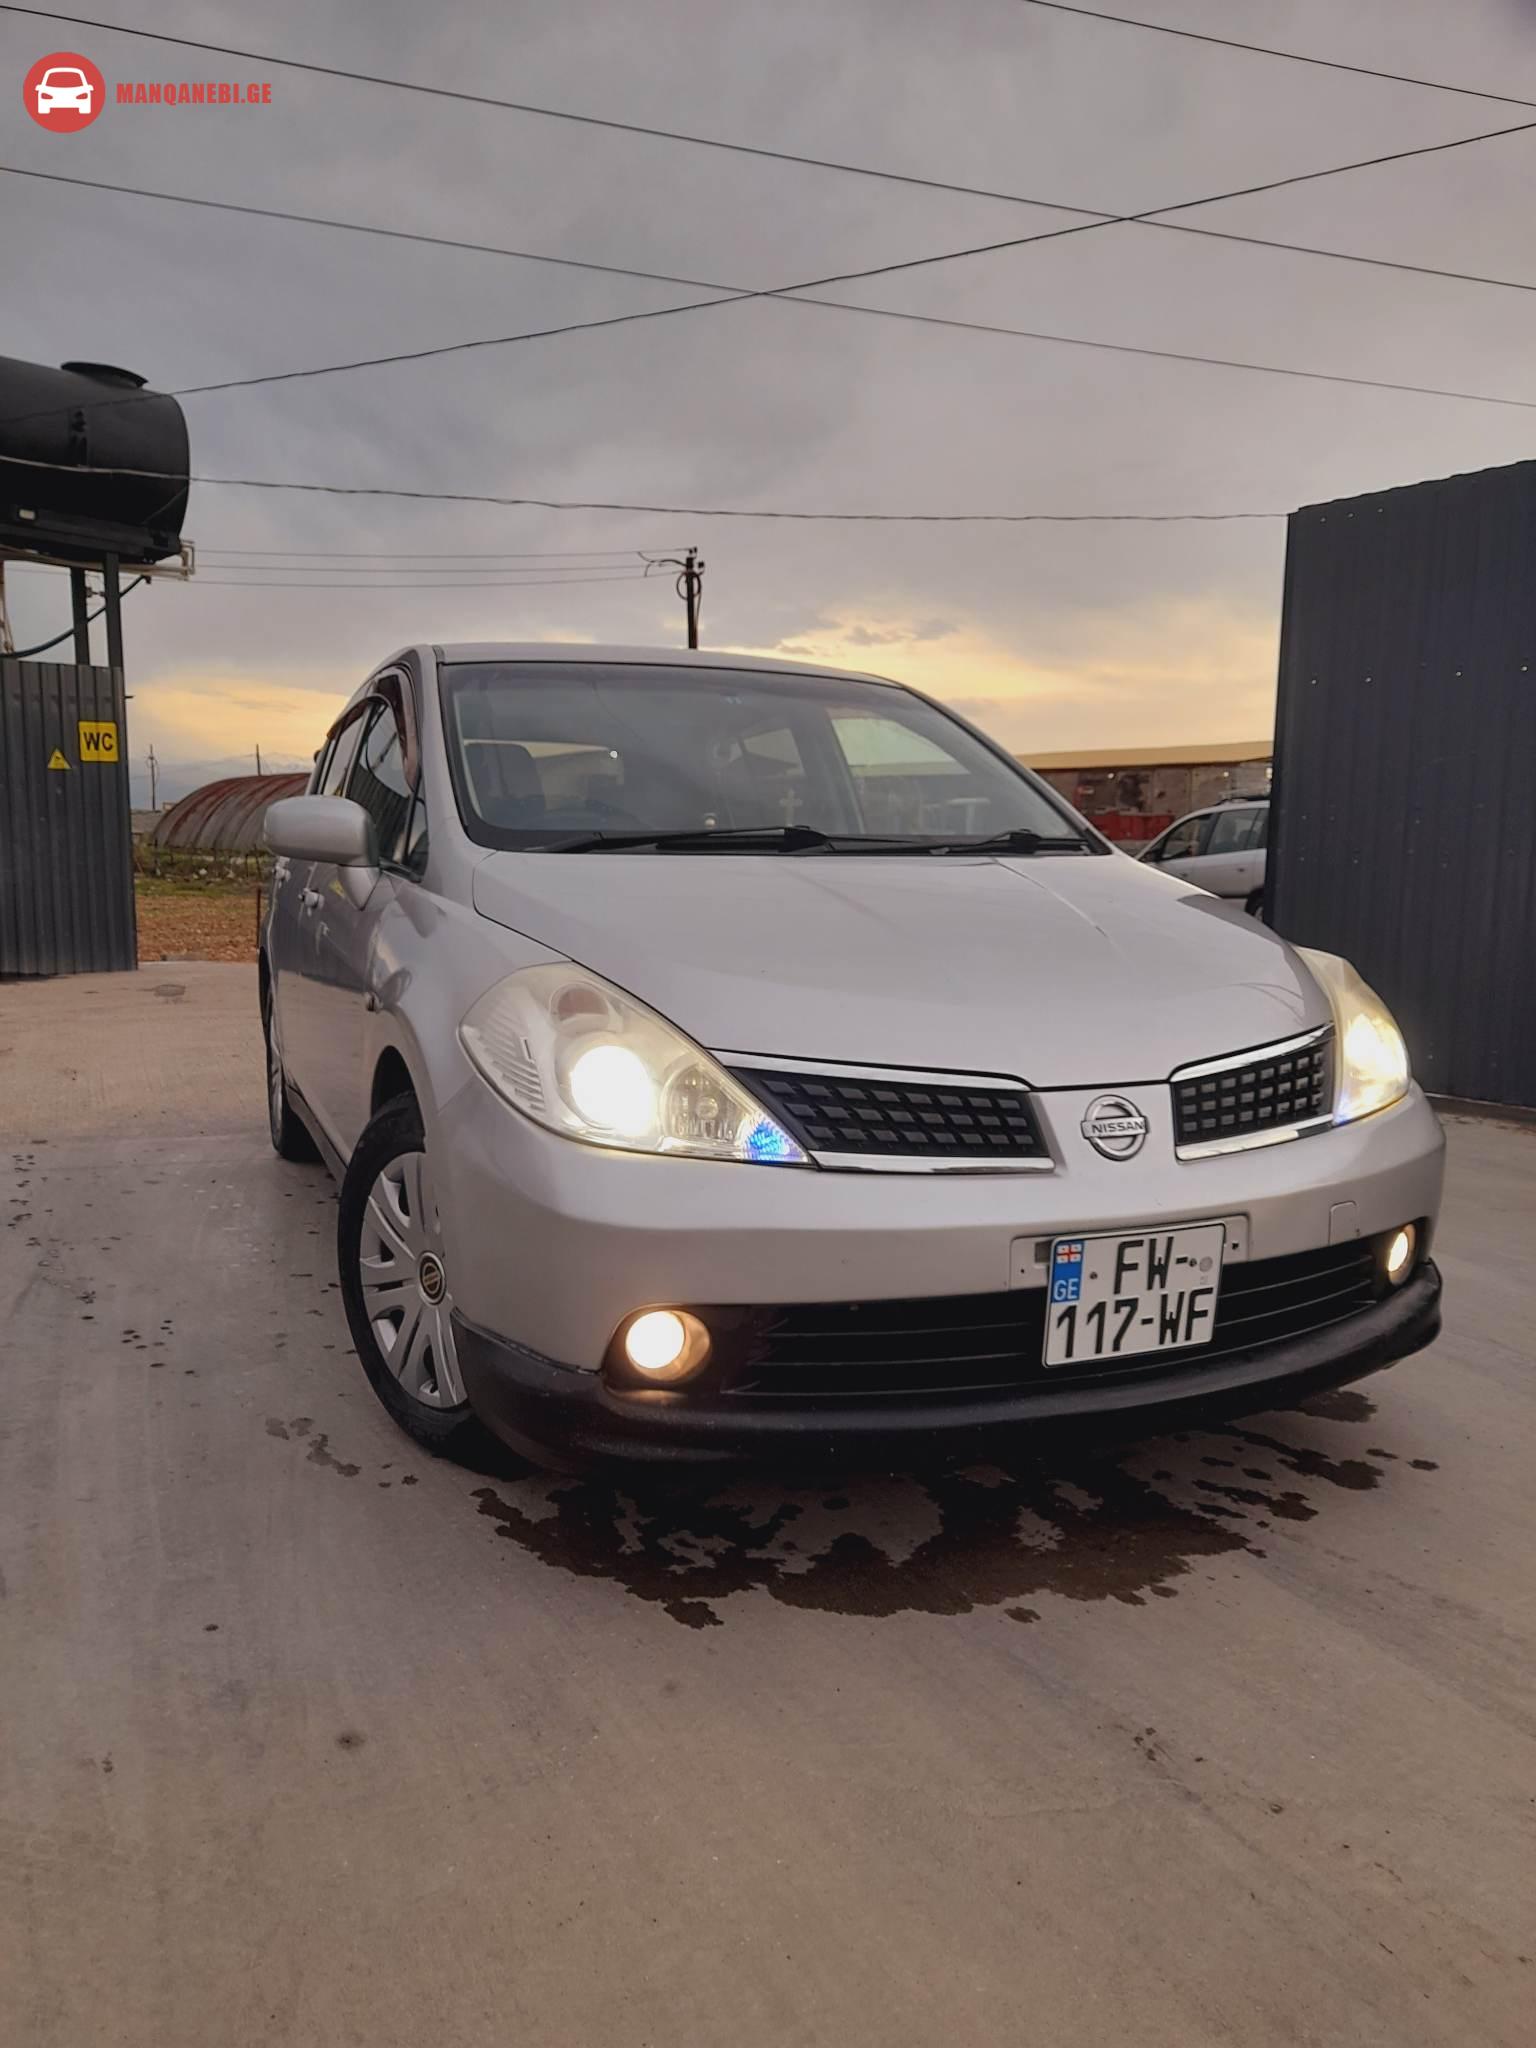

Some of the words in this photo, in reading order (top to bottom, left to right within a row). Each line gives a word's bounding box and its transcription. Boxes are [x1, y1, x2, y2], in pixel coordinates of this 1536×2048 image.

[83, 732, 114, 751] WC
[1092, 1121, 1144, 1133] NISSAN
[1053, 1278, 1079, 1300] GE
[1056, 1287, 1213, 1358] 117-WF
